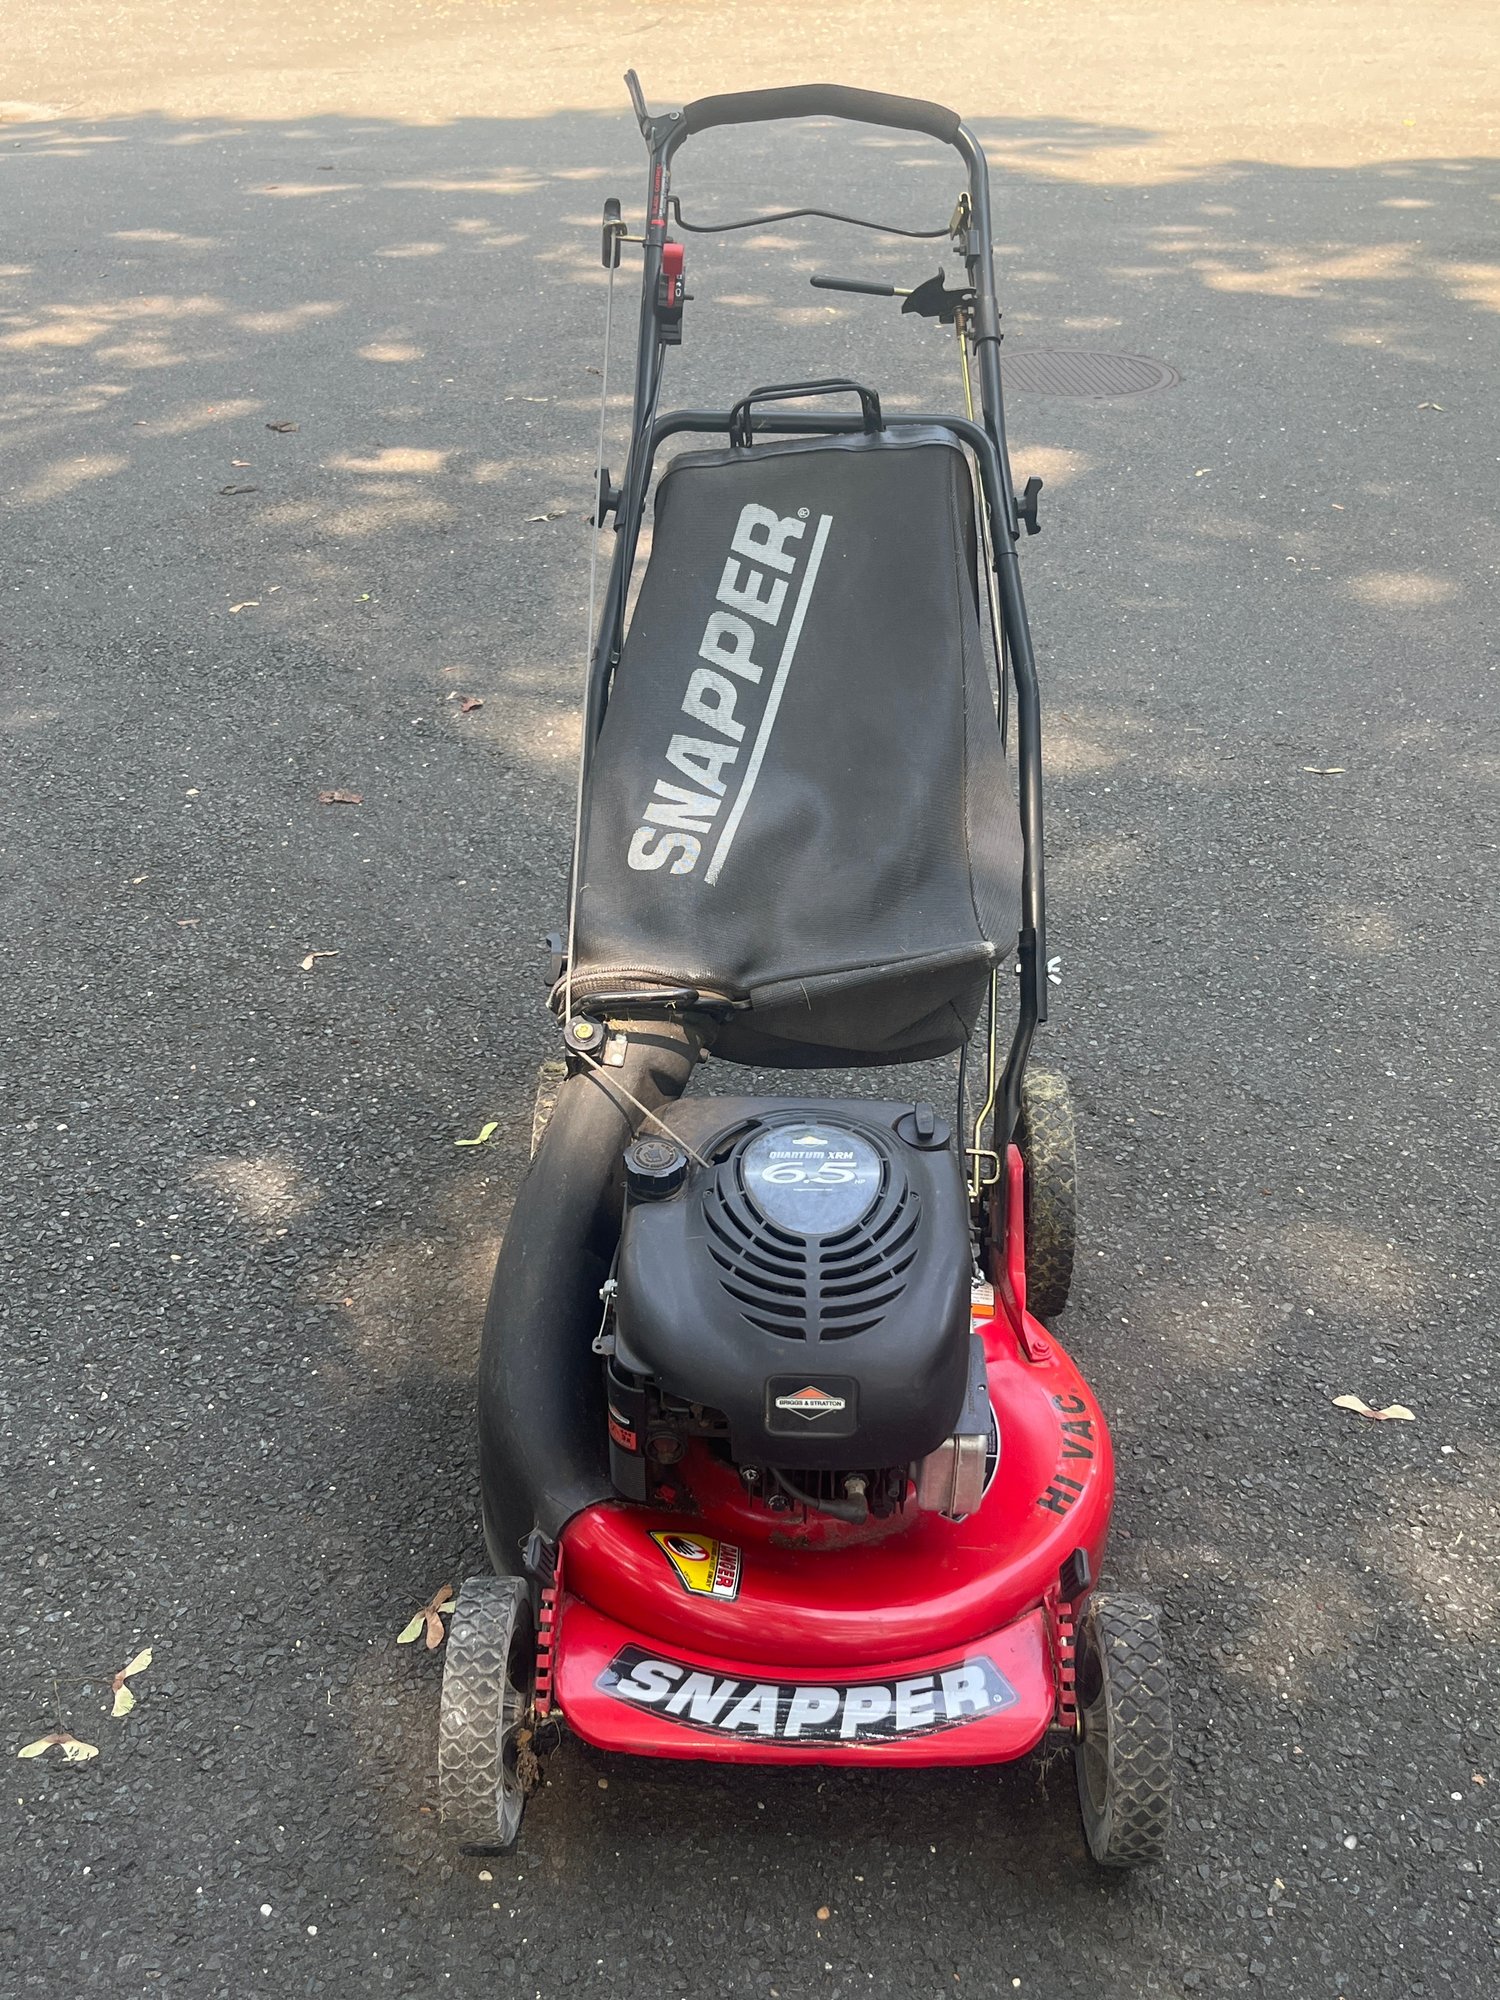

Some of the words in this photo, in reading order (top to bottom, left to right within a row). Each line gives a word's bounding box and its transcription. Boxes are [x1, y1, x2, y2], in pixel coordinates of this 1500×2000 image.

[628, 503, 806, 875] SNAPPER
[762, 1161, 857, 1184] 6.5
[769, 1151, 825, 1159] QUANTUM
[827, 1151, 854, 1159] XRM
[1052, 1394, 1094, 1459] VAC
[1036, 1474, 1084, 1515] HI
[716, 1543, 738, 1588] DANGER
[617, 1659, 990, 1738] SNAPPER
